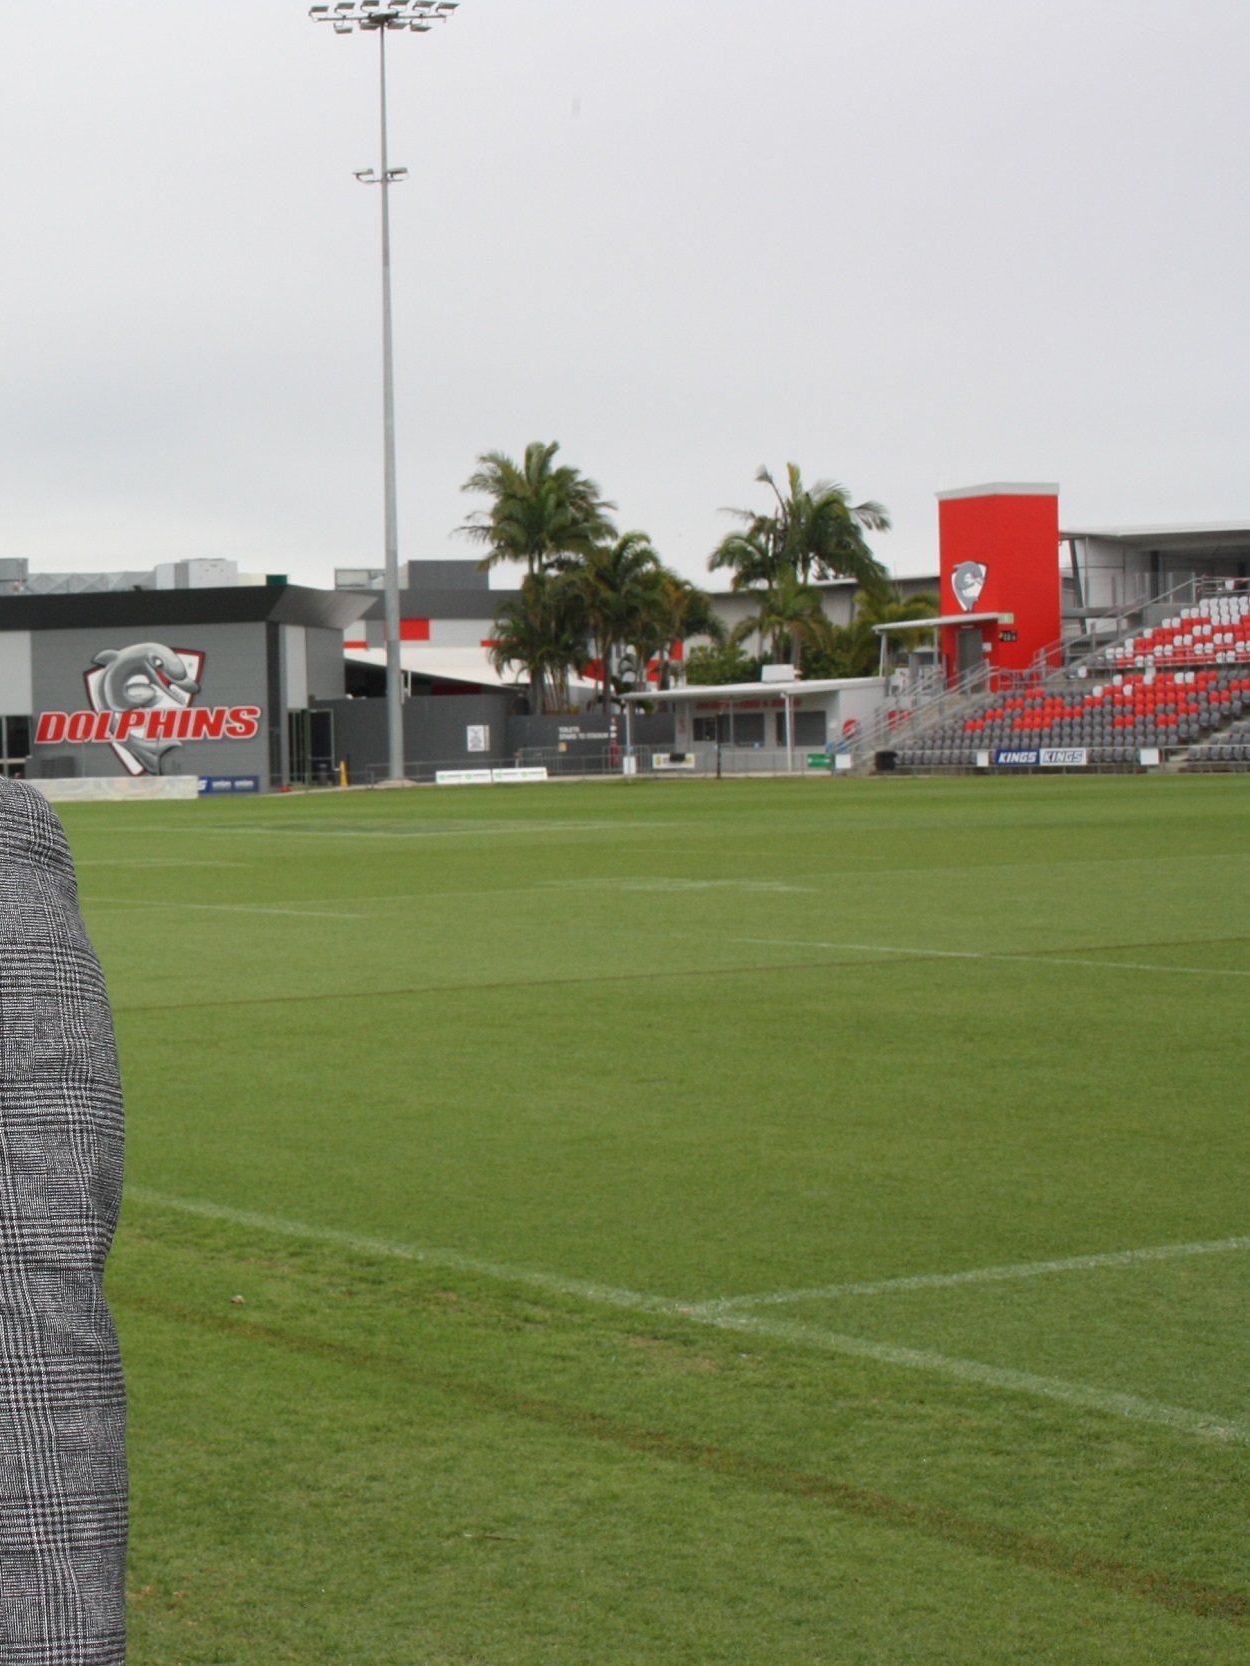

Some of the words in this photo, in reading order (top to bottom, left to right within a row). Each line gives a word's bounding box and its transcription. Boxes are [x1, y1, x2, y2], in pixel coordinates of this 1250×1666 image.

[34, 706, 261, 743] DOLPHINS
[999, 752, 1037, 763] KINGS
[1043, 751, 1082, 762] KINGS
